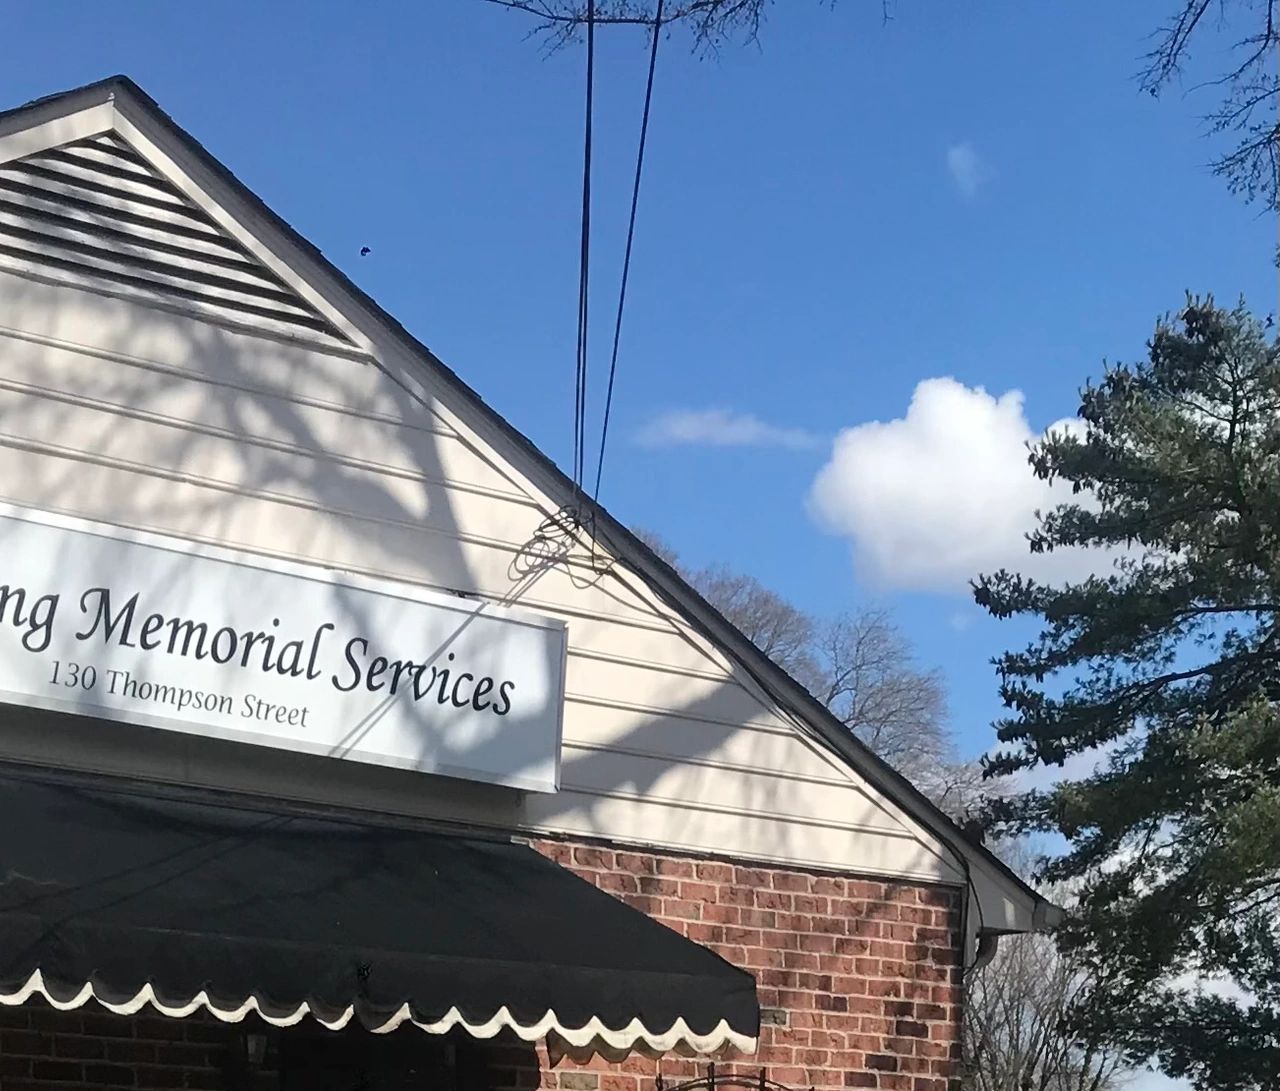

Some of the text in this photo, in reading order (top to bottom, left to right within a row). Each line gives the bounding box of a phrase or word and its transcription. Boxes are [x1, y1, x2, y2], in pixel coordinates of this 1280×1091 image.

[49, 660, 310, 728] 130 Thompson Street
[75, 587, 335, 680] Memorial
[331, 637, 516, 716] Services
